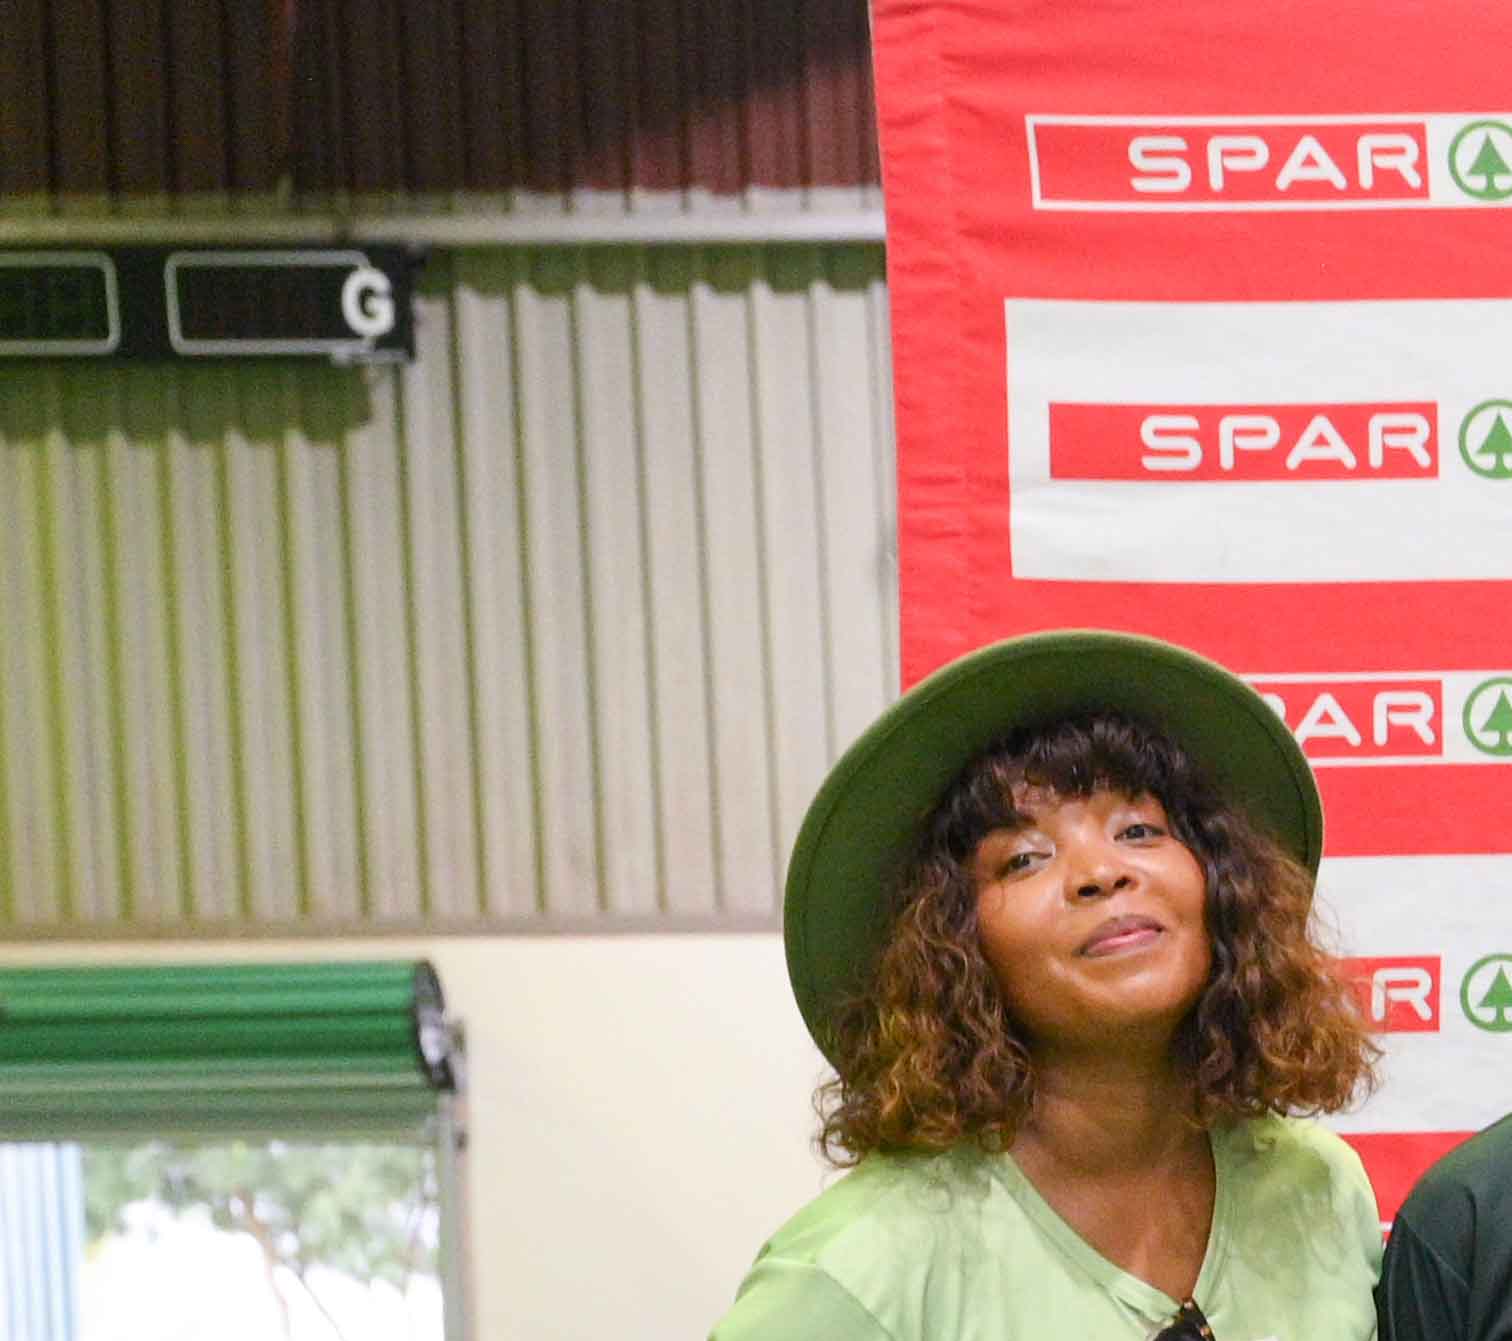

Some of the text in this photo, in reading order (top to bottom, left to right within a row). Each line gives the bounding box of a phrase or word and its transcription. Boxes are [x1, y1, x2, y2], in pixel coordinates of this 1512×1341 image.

[1130, 135, 1421, 191] SPAR
[342, 267, 395, 338] G
[1141, 414, 1431, 469] SPAR
